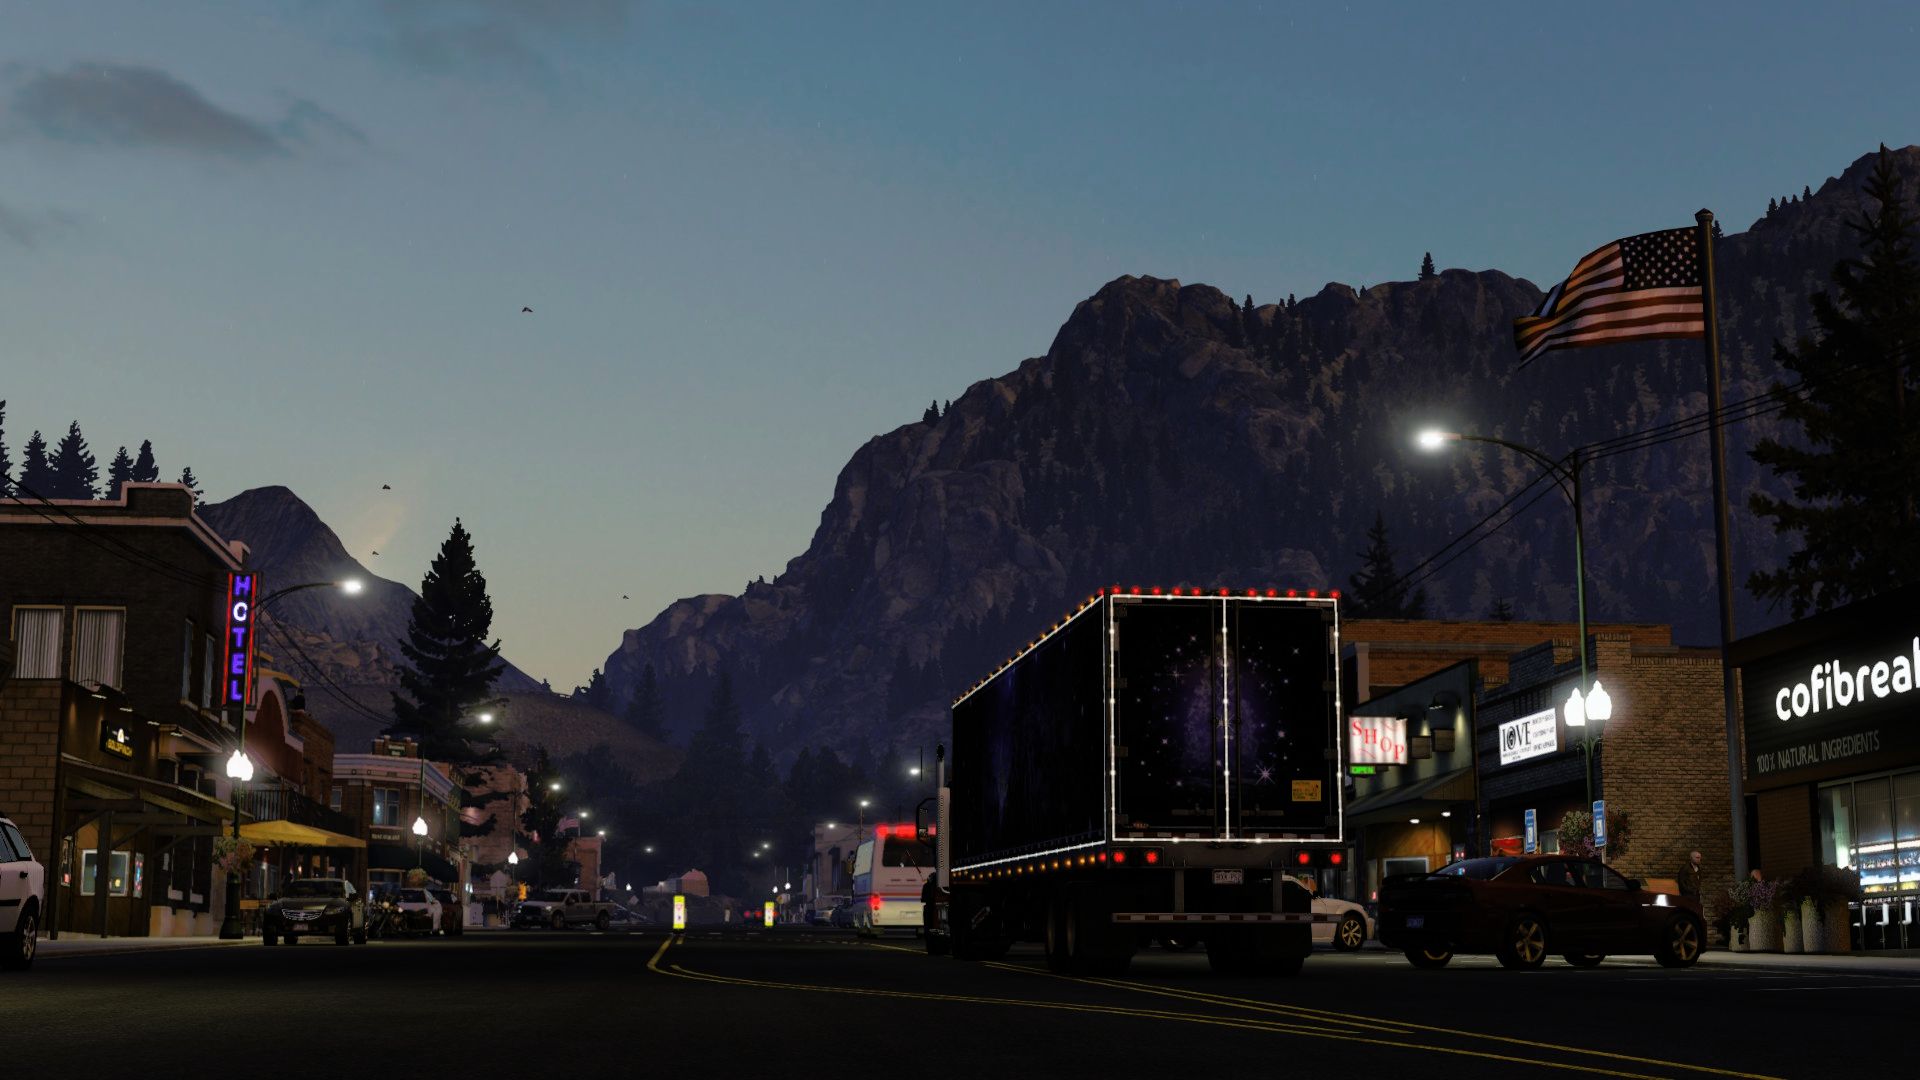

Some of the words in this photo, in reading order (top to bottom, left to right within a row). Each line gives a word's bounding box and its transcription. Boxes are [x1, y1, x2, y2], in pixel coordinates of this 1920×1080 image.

[230, 574, 252, 702] HOTEL
[1352, 721, 1404, 760] SHOP
[1757, 752, 1775, 774] 100%
[1778, 743, 1819, 770] NATURAL
[1821, 729, 1880, 761] INGREDIENTS
